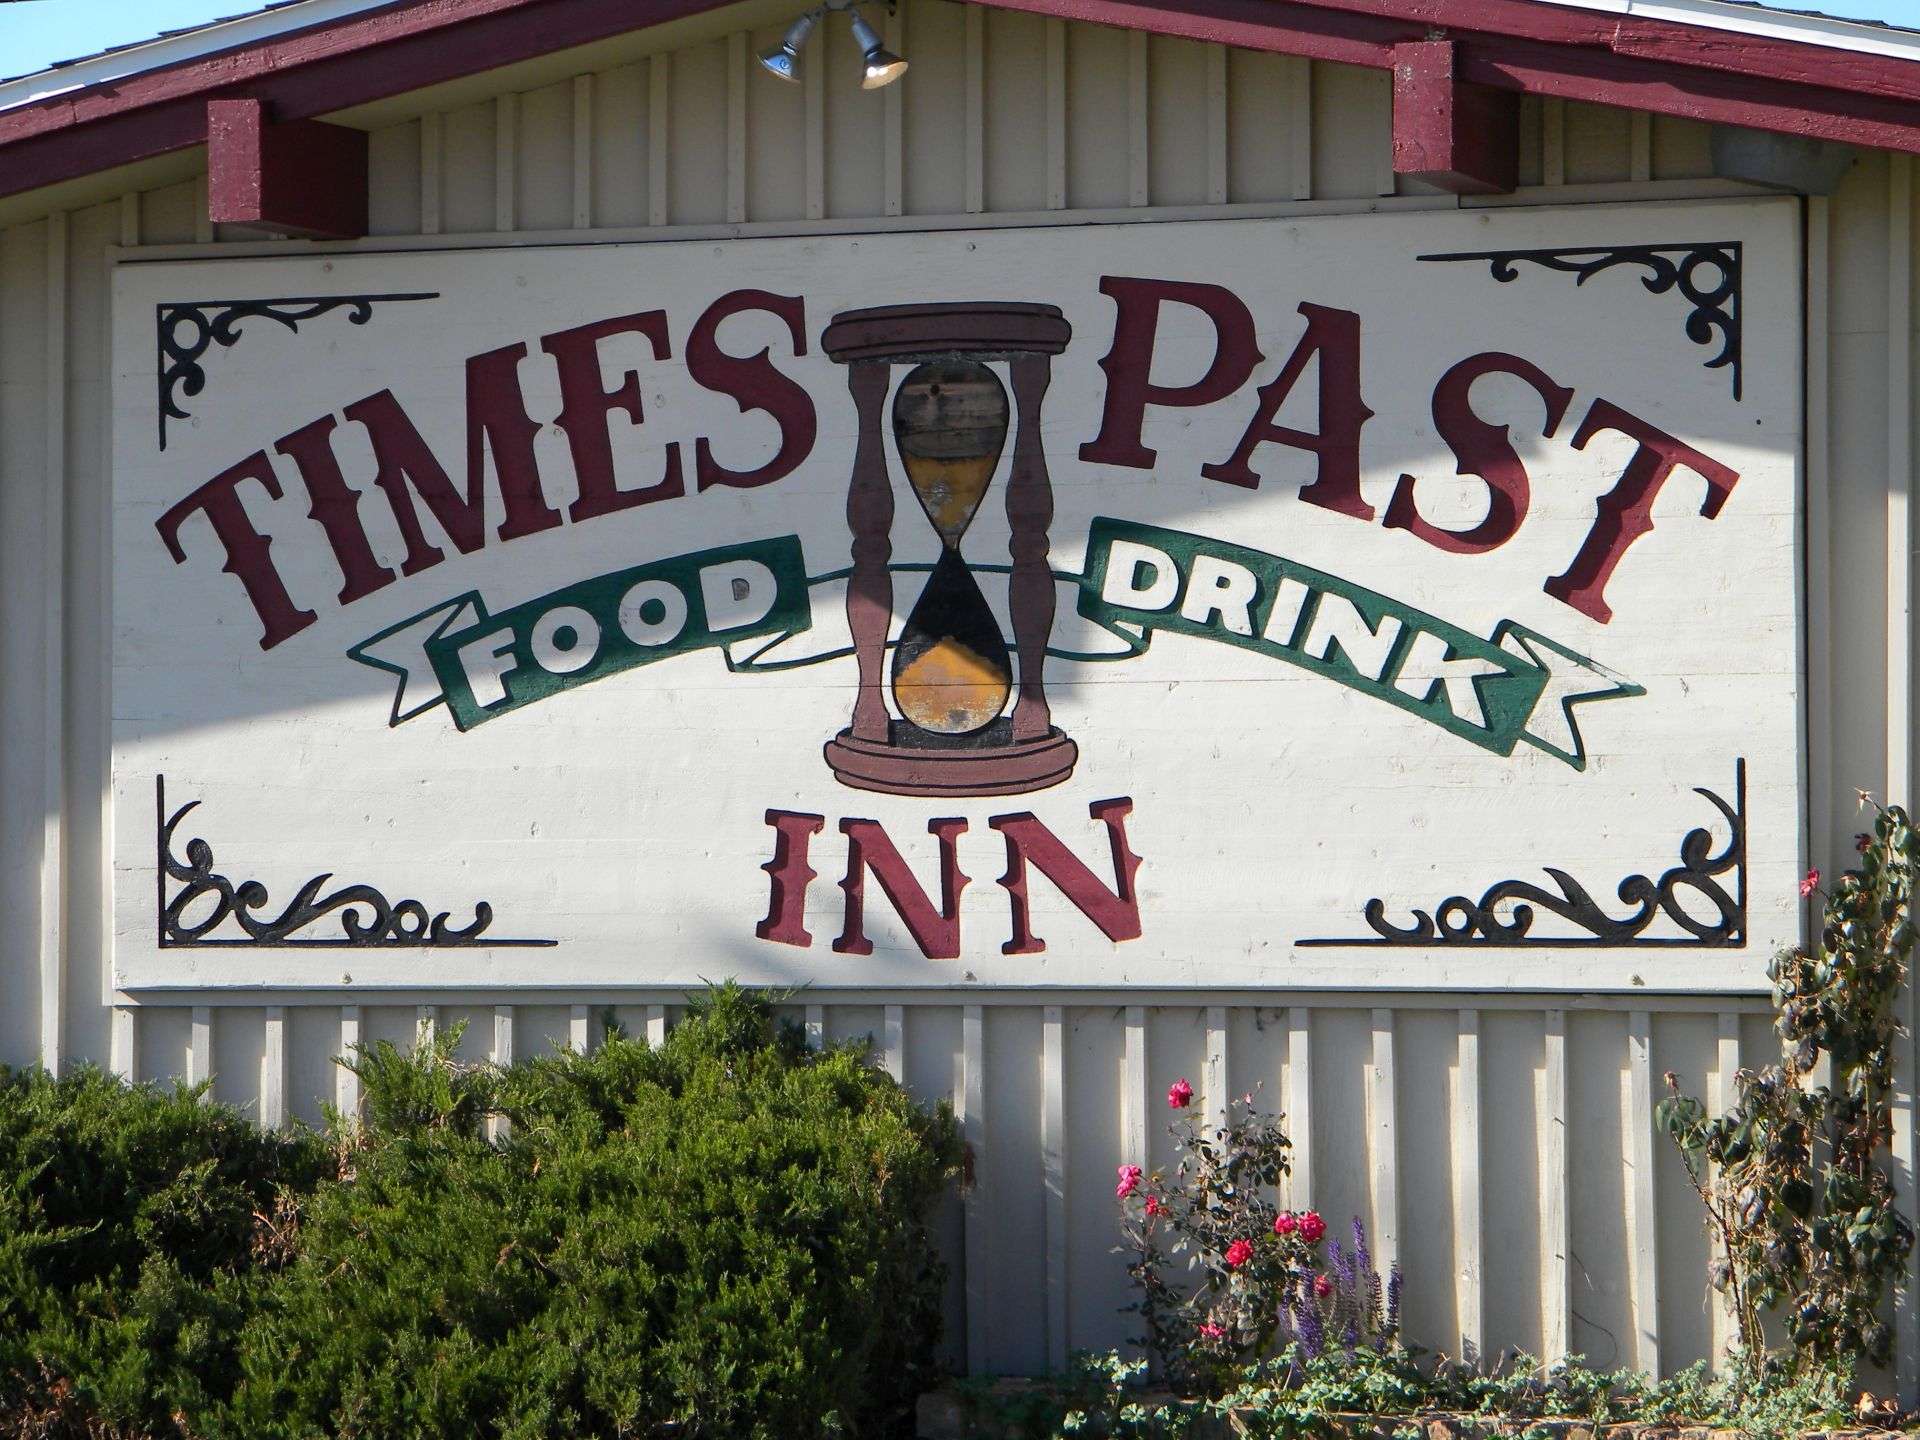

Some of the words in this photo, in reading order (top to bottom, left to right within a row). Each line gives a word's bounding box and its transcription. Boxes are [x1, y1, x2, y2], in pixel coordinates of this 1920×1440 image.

[155, 289, 818, 651] TIMES
[1079, 276, 1739, 623] PAST
[456, 559, 779, 709] FOOD
[1101, 539, 1507, 727] DRINK
[757, 798, 1142, 957] INN
